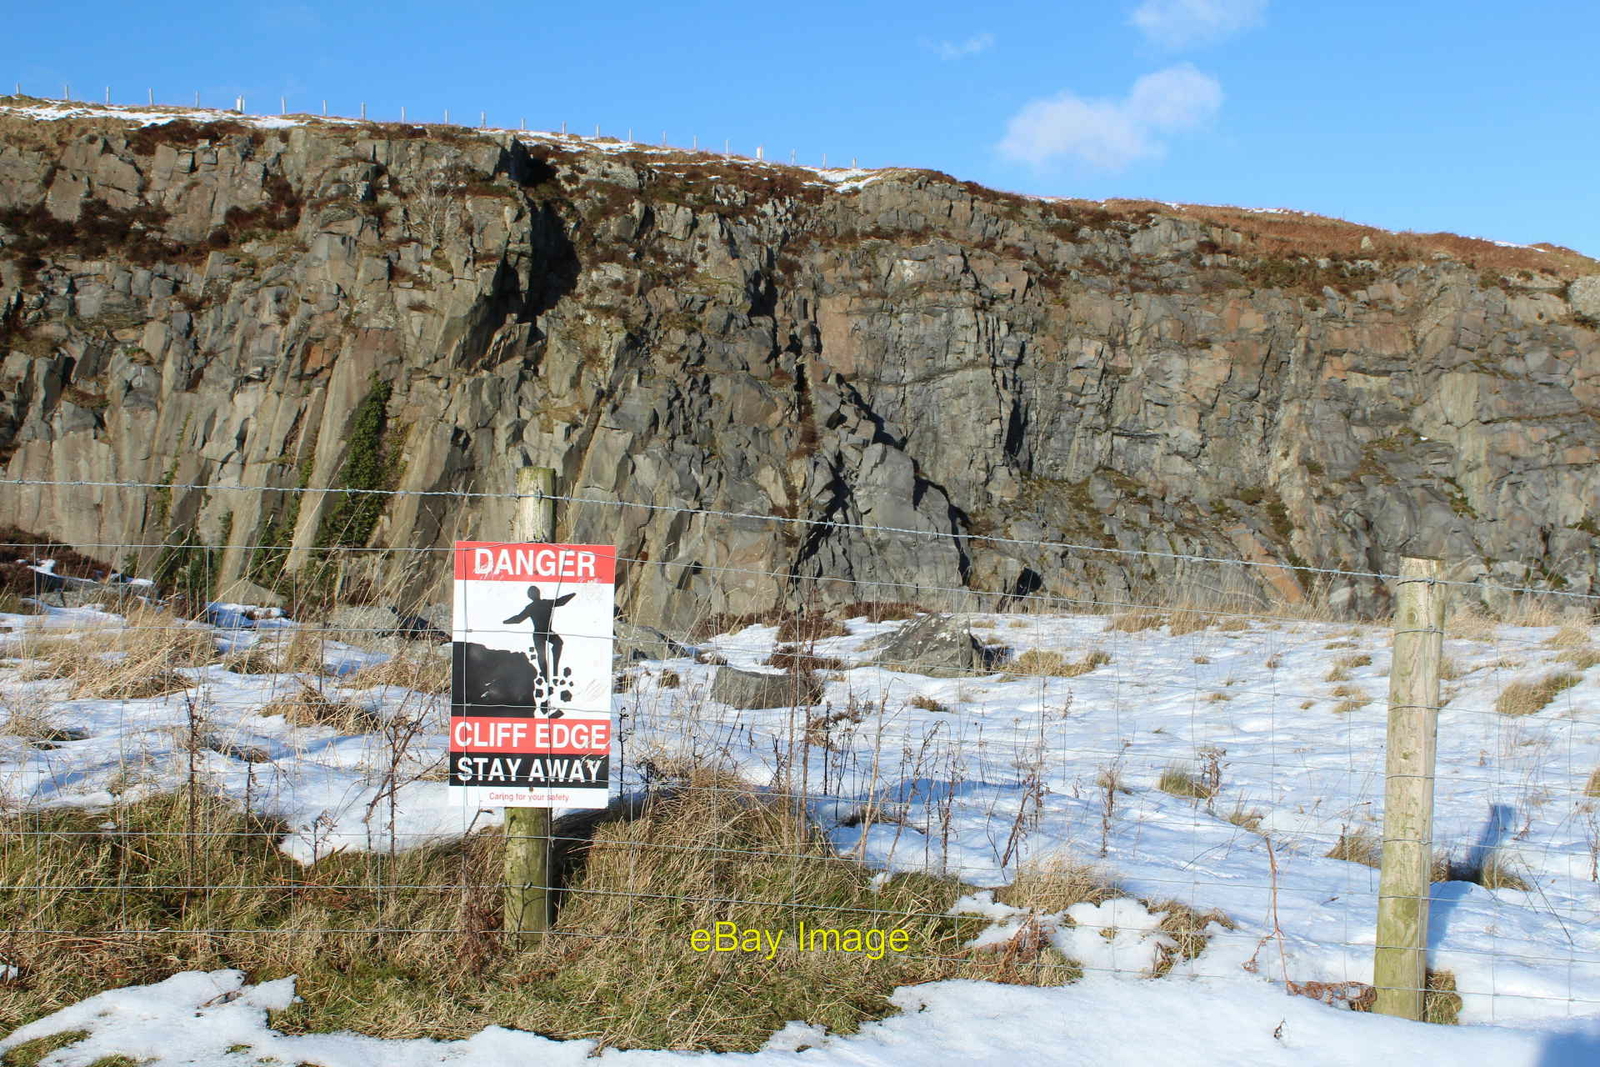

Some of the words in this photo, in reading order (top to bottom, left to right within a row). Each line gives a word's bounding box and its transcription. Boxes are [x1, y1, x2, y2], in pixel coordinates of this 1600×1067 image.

[474, 548, 596, 578] DANGER
[454, 721, 527, 748] CLIFF
[535, 723, 606, 750] EDGE
[457, 756, 522, 782] STAY
[528, 758, 602, 783] AWAY
[489, 792, 514, 802] Caring
[515, 793, 526, 801] for
[527, 794, 545, 803] your
